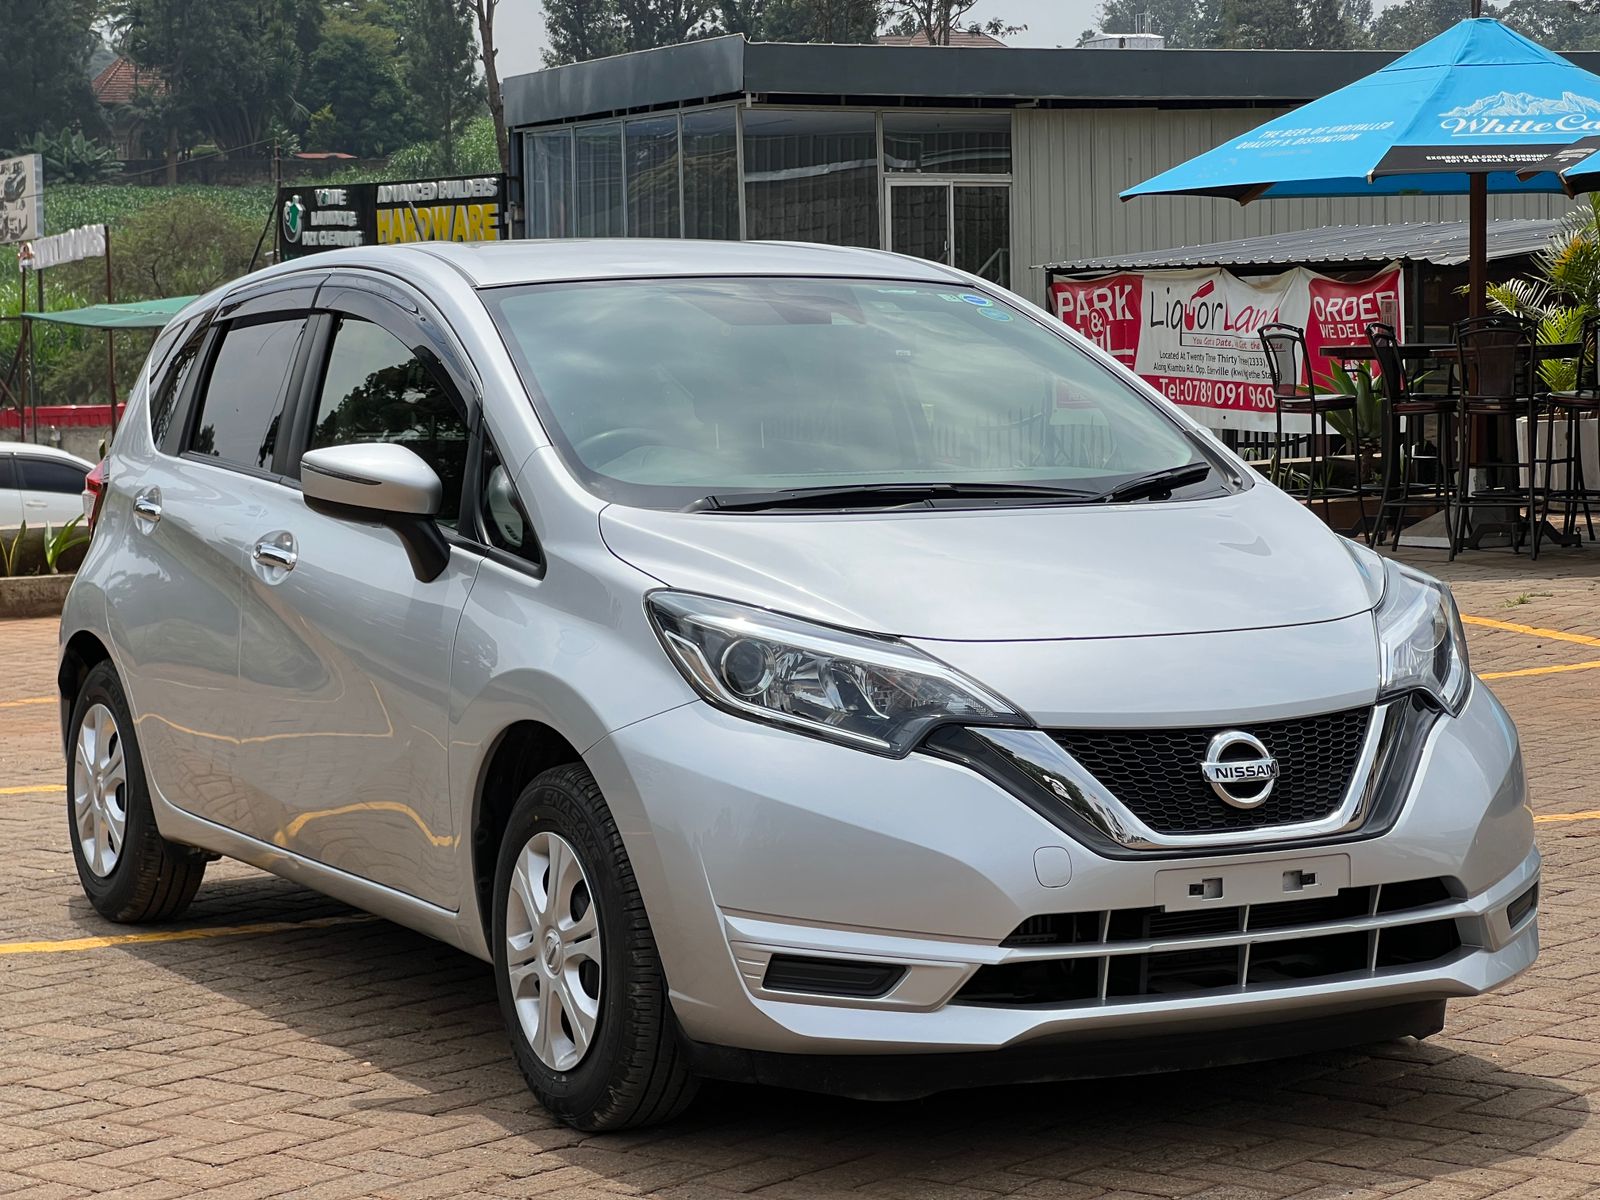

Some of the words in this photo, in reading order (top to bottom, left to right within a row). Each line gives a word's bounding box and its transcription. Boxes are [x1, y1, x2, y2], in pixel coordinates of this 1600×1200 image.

[1441, 117, 1552, 133] White
[1236, 139, 1281, 149] QUALITY
[1292, 133, 1361, 145] DISTINCTION
[377, 182, 437, 203] ADVANCED
[439, 177, 498, 199] BUILDERS
[377, 203, 499, 244] HARDWARE
[1056, 285, 1134, 324] PARK
[1091, 311, 1104, 333] &
[1319, 324, 1337, 338] WE
[1160, 351, 1179, 360] Located
[1187, 352, 1205, 363] Twenty
[1217, 354, 1237, 366] Thirty
[1215, 383, 1244, 405] 091
[1249, 387, 1275, 408] 960
[1215, 764, 1276, 778] NISSAN
